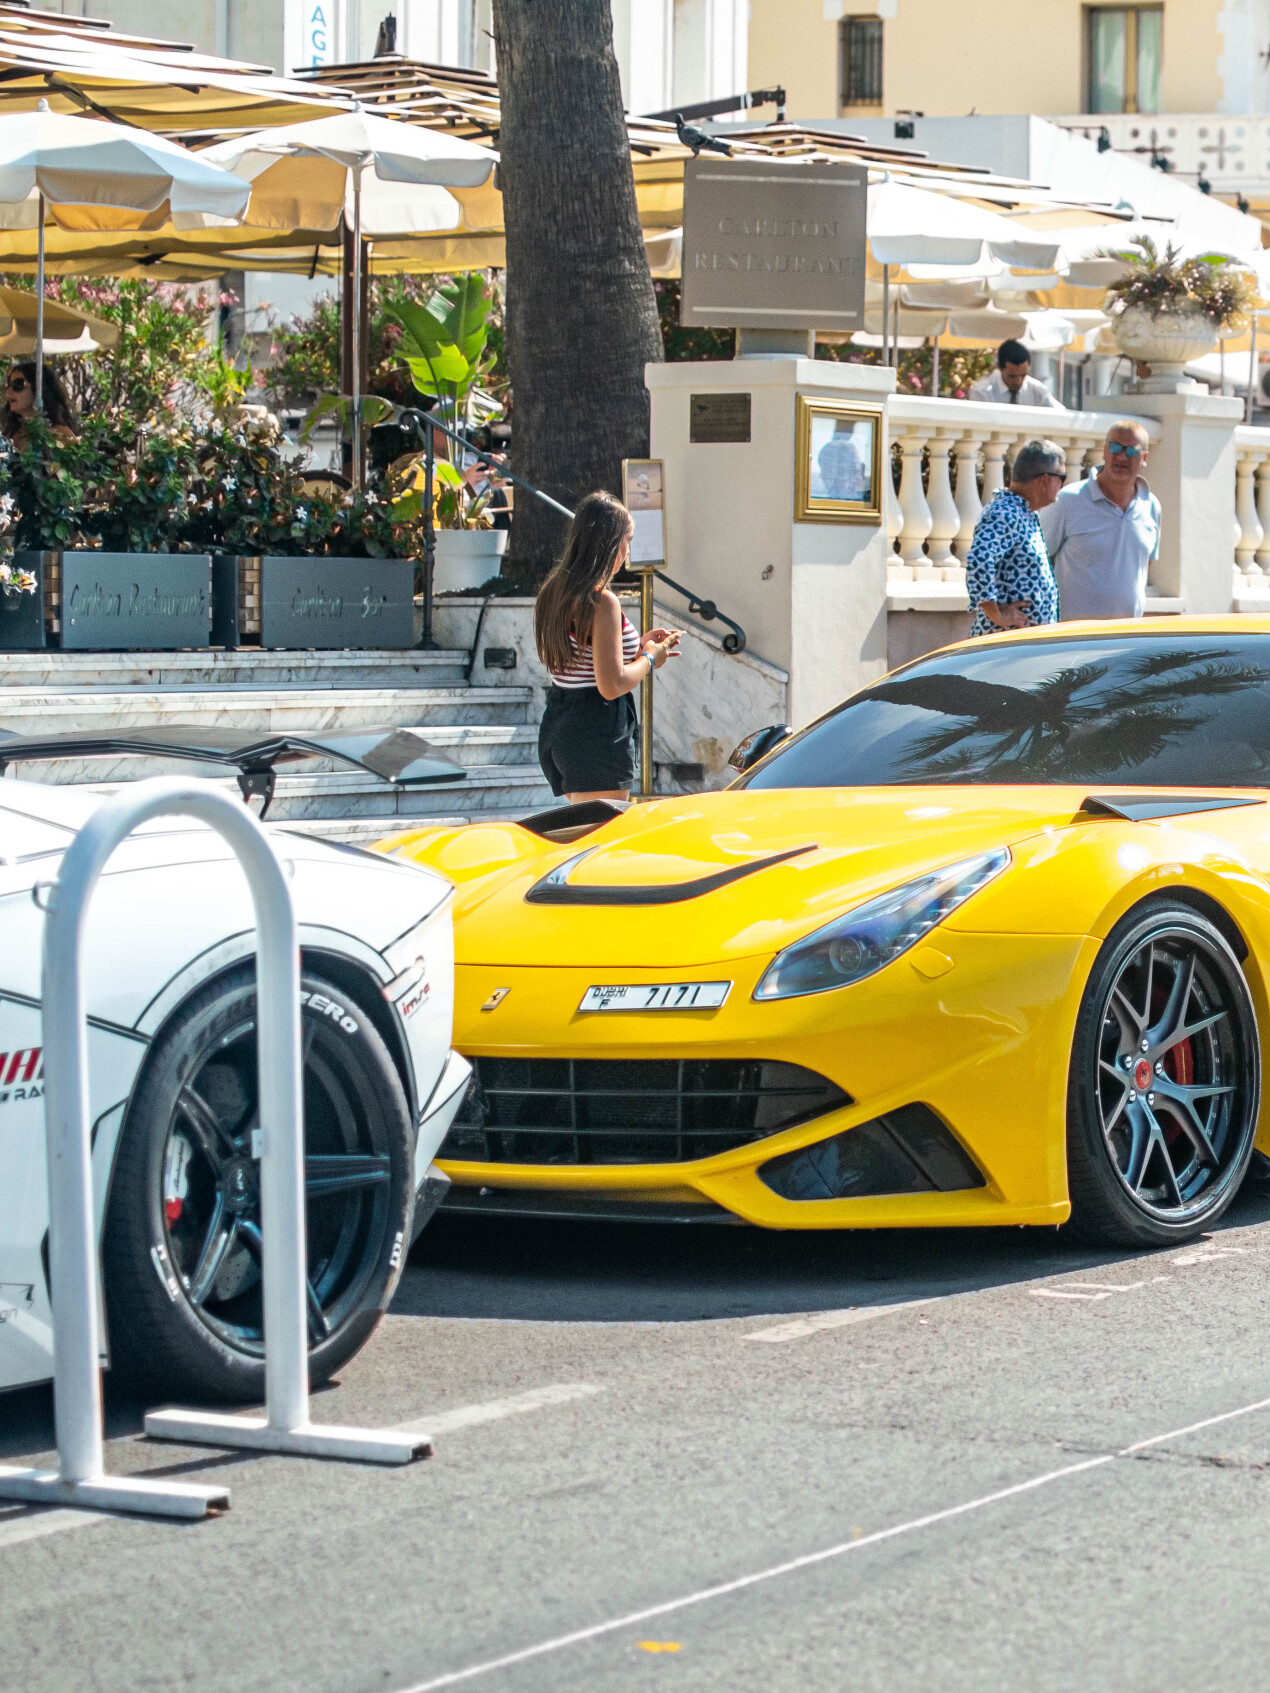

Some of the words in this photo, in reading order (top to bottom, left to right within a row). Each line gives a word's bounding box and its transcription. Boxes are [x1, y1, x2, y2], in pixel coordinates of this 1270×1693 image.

[718, 217, 839, 239] CARLTON
[695, 252, 861, 274] RESTAURANT
[70, 582, 121, 616] Carlton
[129, 583, 205, 616] Restaurant
[292, 586, 343, 618] Carlton
[361, 585, 387, 618] Bar
[645, 986, 701, 1007] 7171
